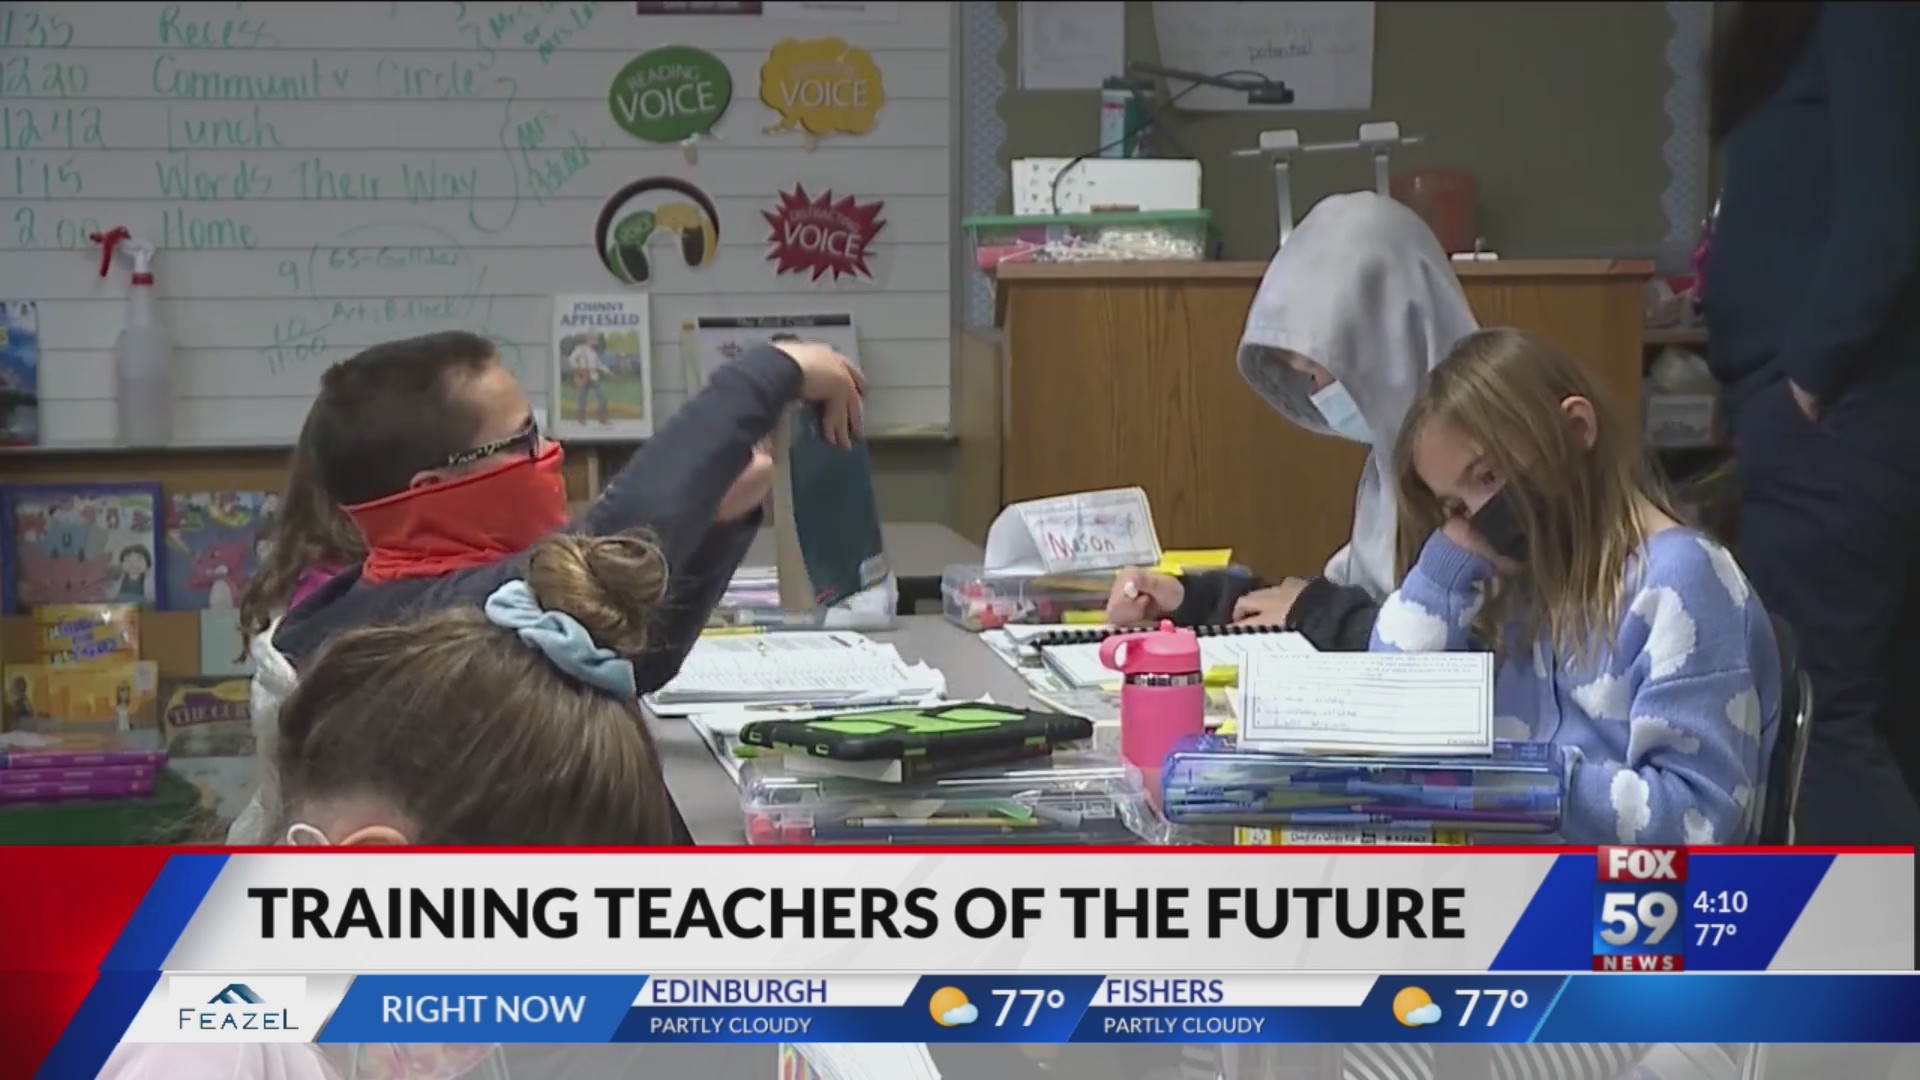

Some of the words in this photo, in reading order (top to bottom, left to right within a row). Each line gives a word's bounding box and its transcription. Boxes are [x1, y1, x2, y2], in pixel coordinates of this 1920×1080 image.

[615, 80, 717, 123] VOICE
[778, 78, 870, 109] VOICE
[166, 104, 284, 152] Lunch
[154, 154, 273, 201] Words
[290, 156, 384, 201] Their
[401, 158, 478, 206] Way
[161, 206, 260, 250] Home
[783, 219, 863, 260] VOICE
[559, 312, 641, 327] APPLESEED
[572, 301, 626, 314] JOHNNY
